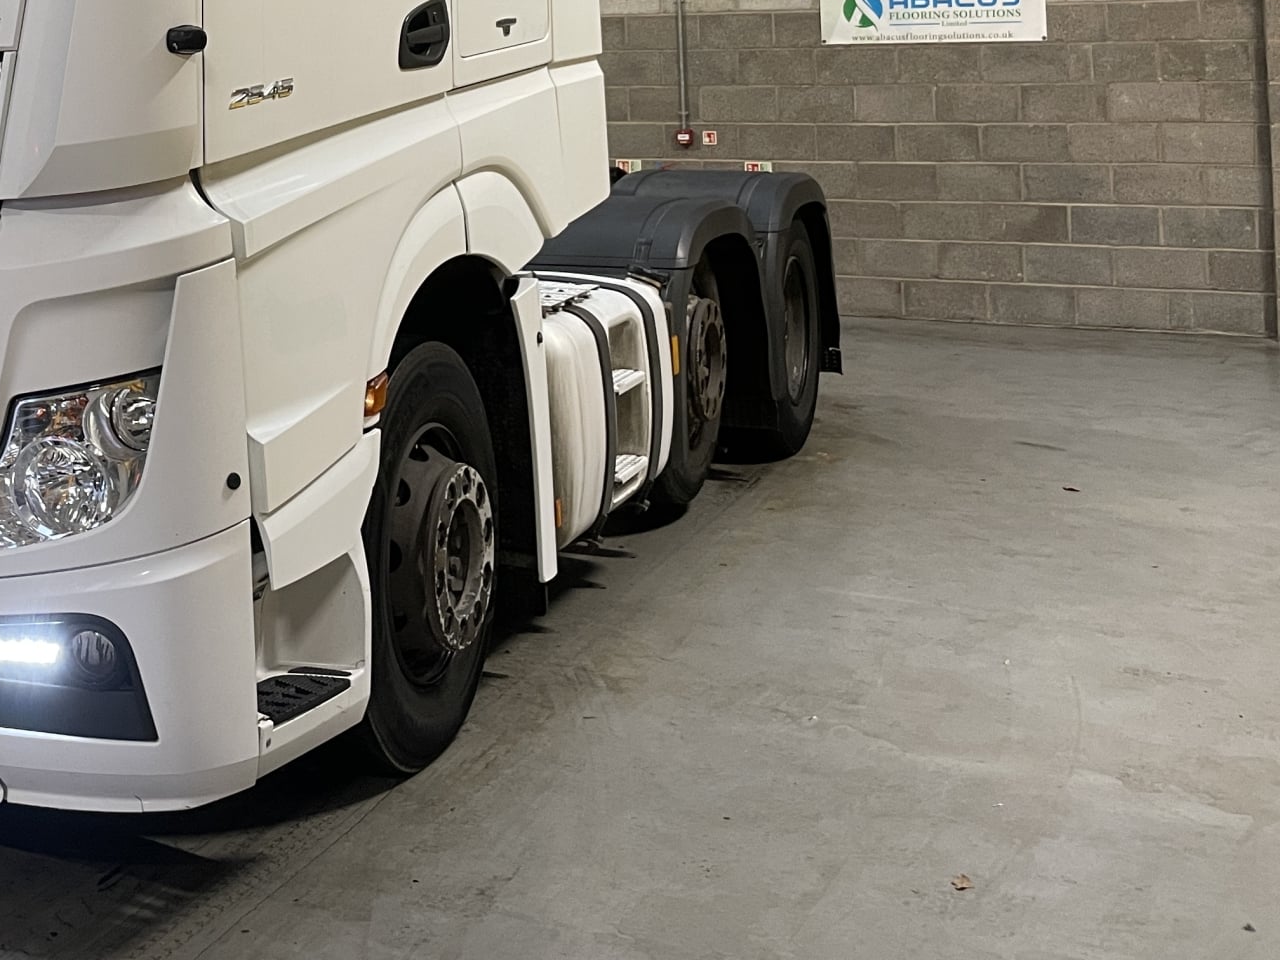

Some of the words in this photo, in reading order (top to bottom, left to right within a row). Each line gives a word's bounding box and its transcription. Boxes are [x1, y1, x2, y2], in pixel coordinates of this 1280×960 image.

[888, 10, 951, 21] FLOORING
[952, 7, 1022, 20] SOLUTIONS
[851, 30, 1014, 42] www.abacusflooringsolutions.co.uk
[228, 77, 294, 111] 2545
